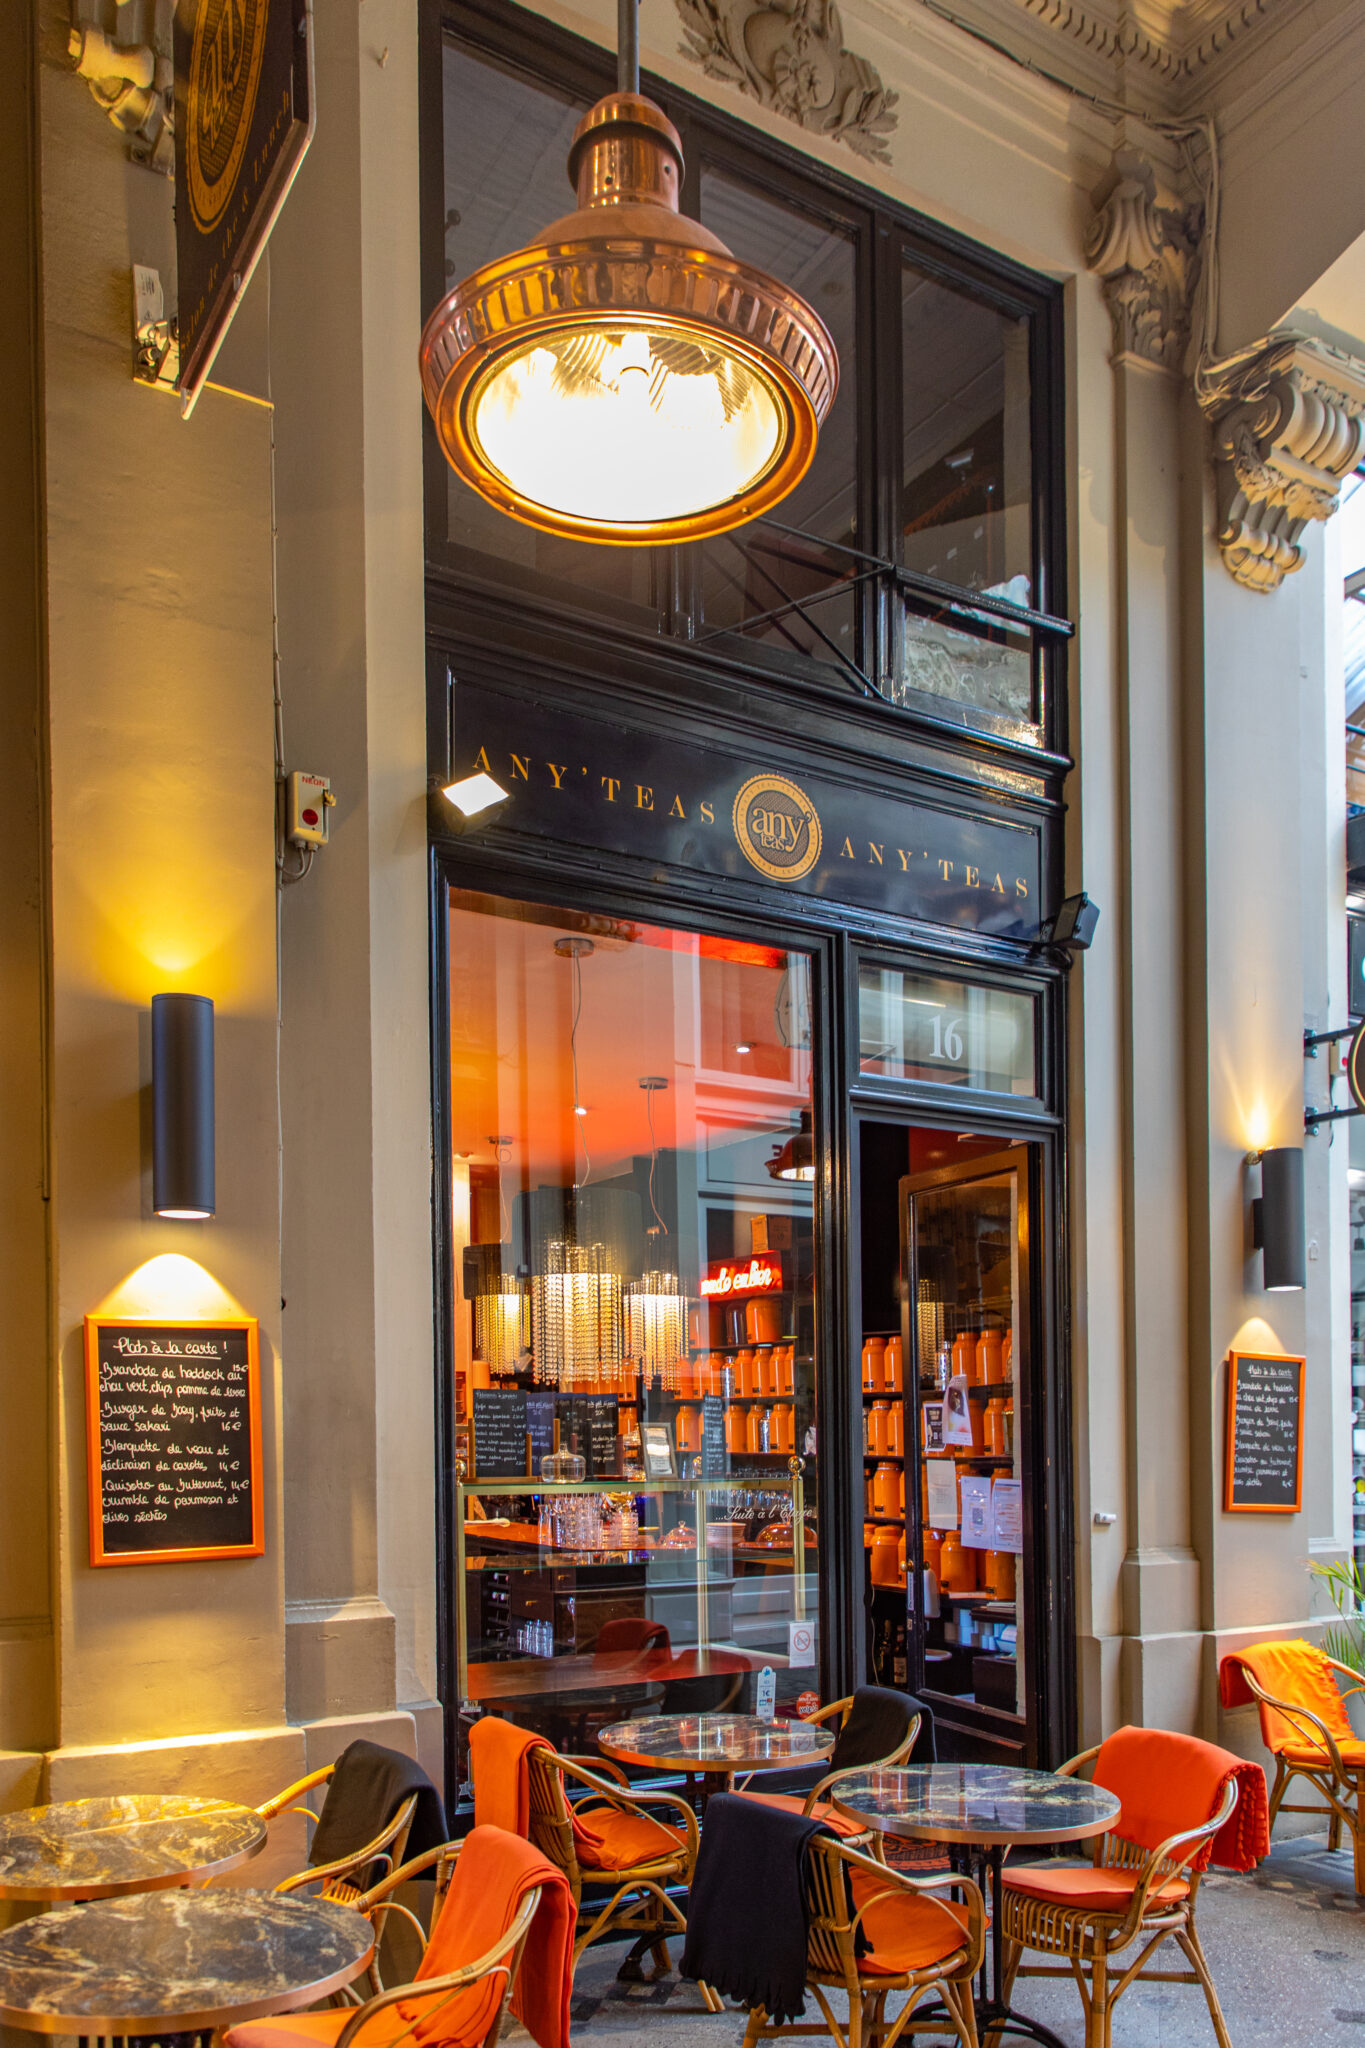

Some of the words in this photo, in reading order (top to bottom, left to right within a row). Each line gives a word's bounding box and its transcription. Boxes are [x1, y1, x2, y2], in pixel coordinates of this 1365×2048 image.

[472, 745, 715, 825] ANY'TEAS
[761, 832, 785, 851] teas
[839, 836, 1028, 898] ANY'TEAS
[929, 1015, 963, 1062] 16
[113, 1337, 148, 1354] Plats
[151, 1341, 164, 1353] à
[165, 1341, 182, 1354] la
[185, 1341, 218, 1354] carte
[161, 1367, 176, 1379] de
[180, 1364, 224, 1380] haddock
[227, 1371, 242, 1381] au
[100, 1380, 123, 1392] chou
[176, 1385, 209, 1399] pomme
[210, 1386, 222, 1396] de
[151, 1403, 166, 1416] de
[229, 1407, 240, 1418] et
[167, 1443, 183, 1455] de
[186, 1445, 214, 1455] veau
[217, 1444, 230, 1456] et
[155, 1460, 170, 1472] de
[158, 1482, 174, 1492] au
[102, 1494, 149, 1507] crumble
[154, 1494, 170, 1505] de
[227, 1493, 239, 1505] et
[758, 1507, 766, 1520] à
